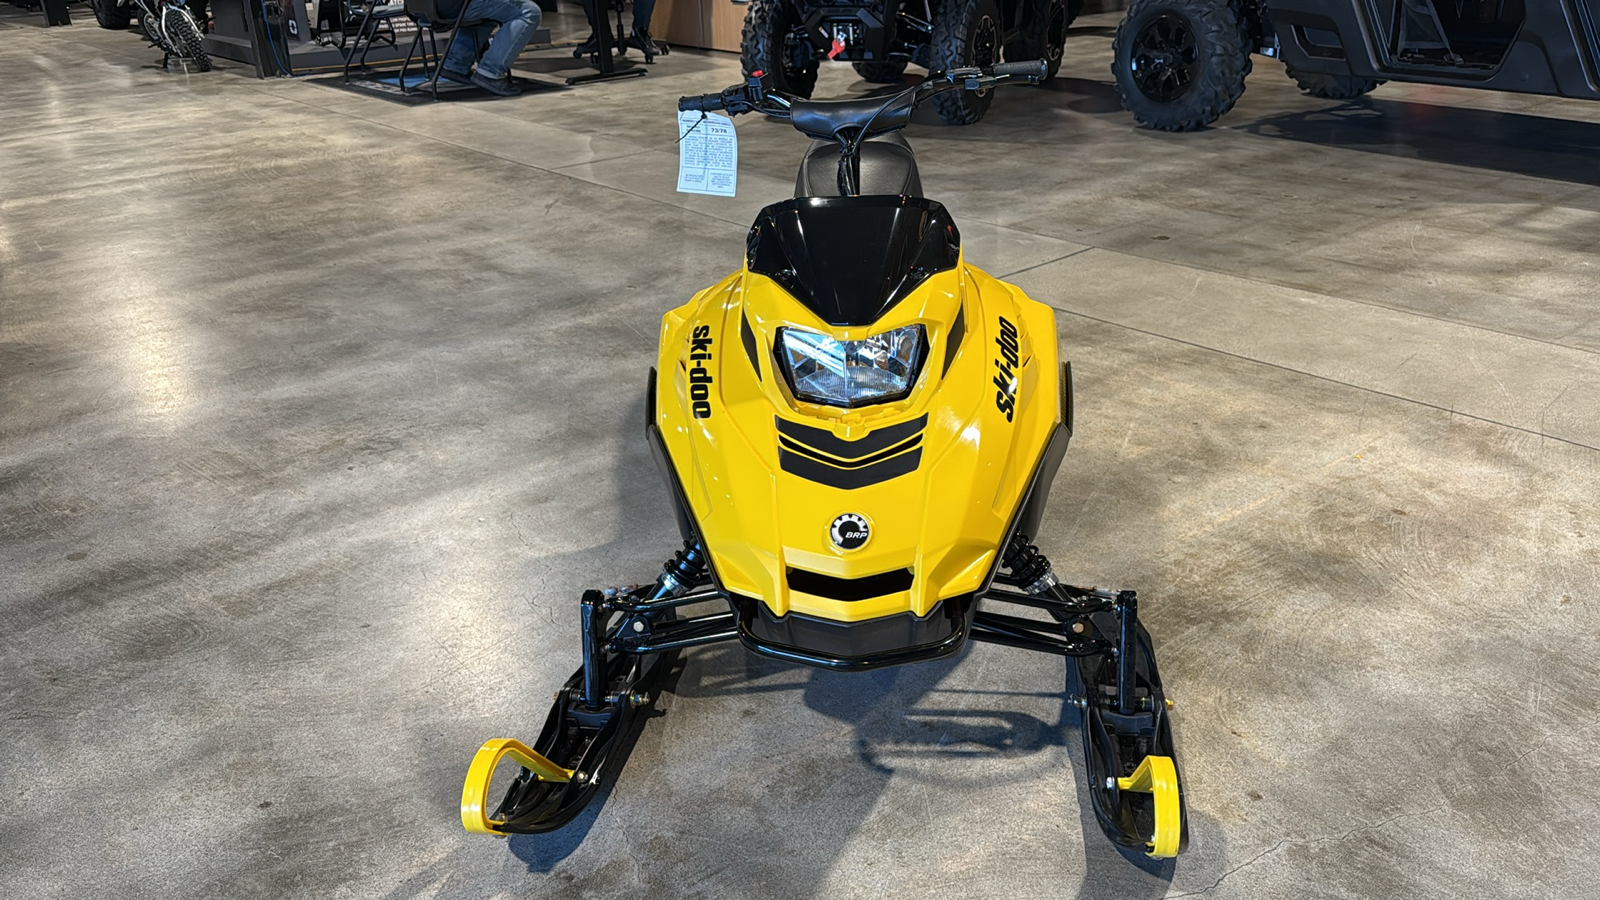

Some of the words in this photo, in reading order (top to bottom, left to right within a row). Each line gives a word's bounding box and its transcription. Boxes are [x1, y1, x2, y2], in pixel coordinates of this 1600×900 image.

[690, 325, 713, 419] ski-doo
[993, 316, 1019, 423] ski-doo
[845, 531, 868, 539] BRP
